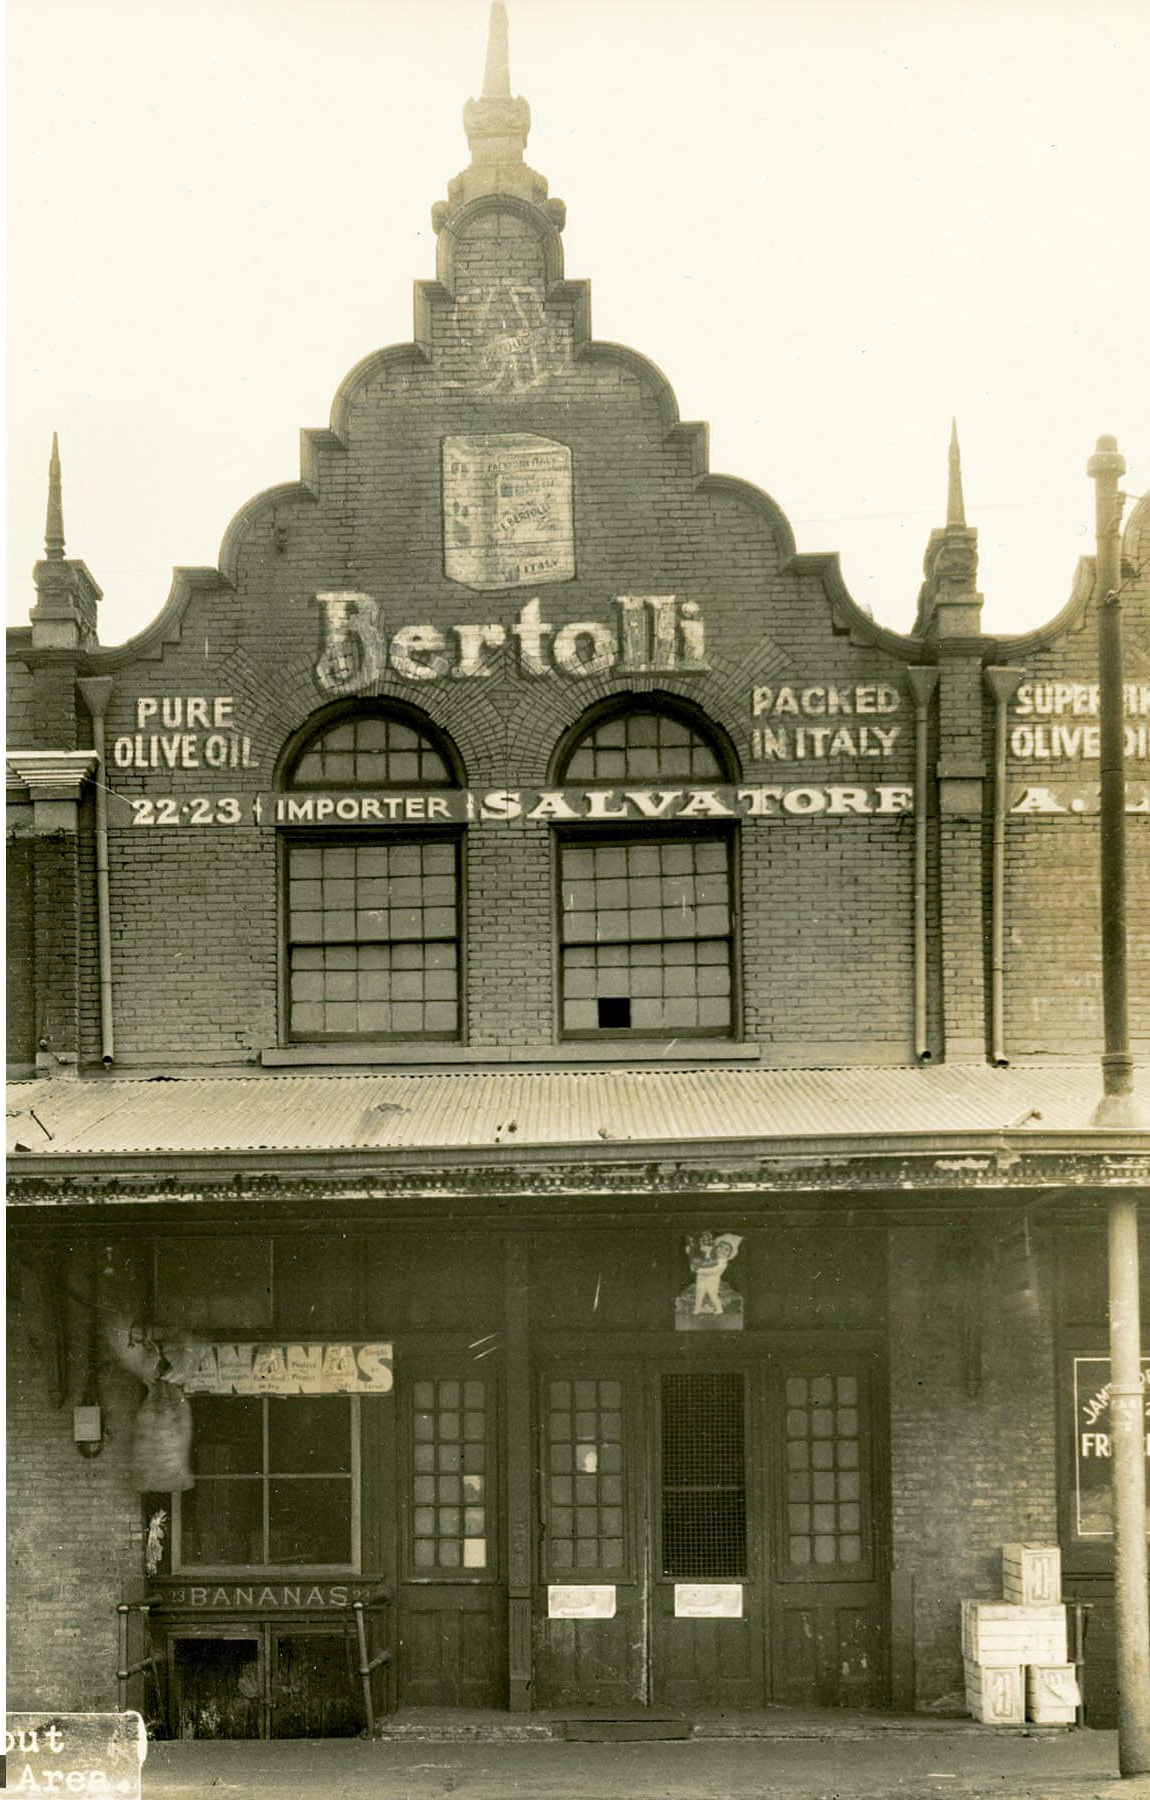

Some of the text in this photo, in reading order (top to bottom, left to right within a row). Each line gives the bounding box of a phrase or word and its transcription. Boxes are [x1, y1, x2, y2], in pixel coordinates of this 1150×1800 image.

[316, 591, 712, 695] Bertolli
[137, 696, 234, 729] PURE
[752, 683, 901, 716] PACKED
[113, 733, 260, 768] OLIVE OIL
[752, 726, 902, 761] IN ITALY
[276, 797, 453, 821] IMPORTER
[480, 786, 915, 822] SALVATORE
[190, 1585, 350, 1607] BANANAS
